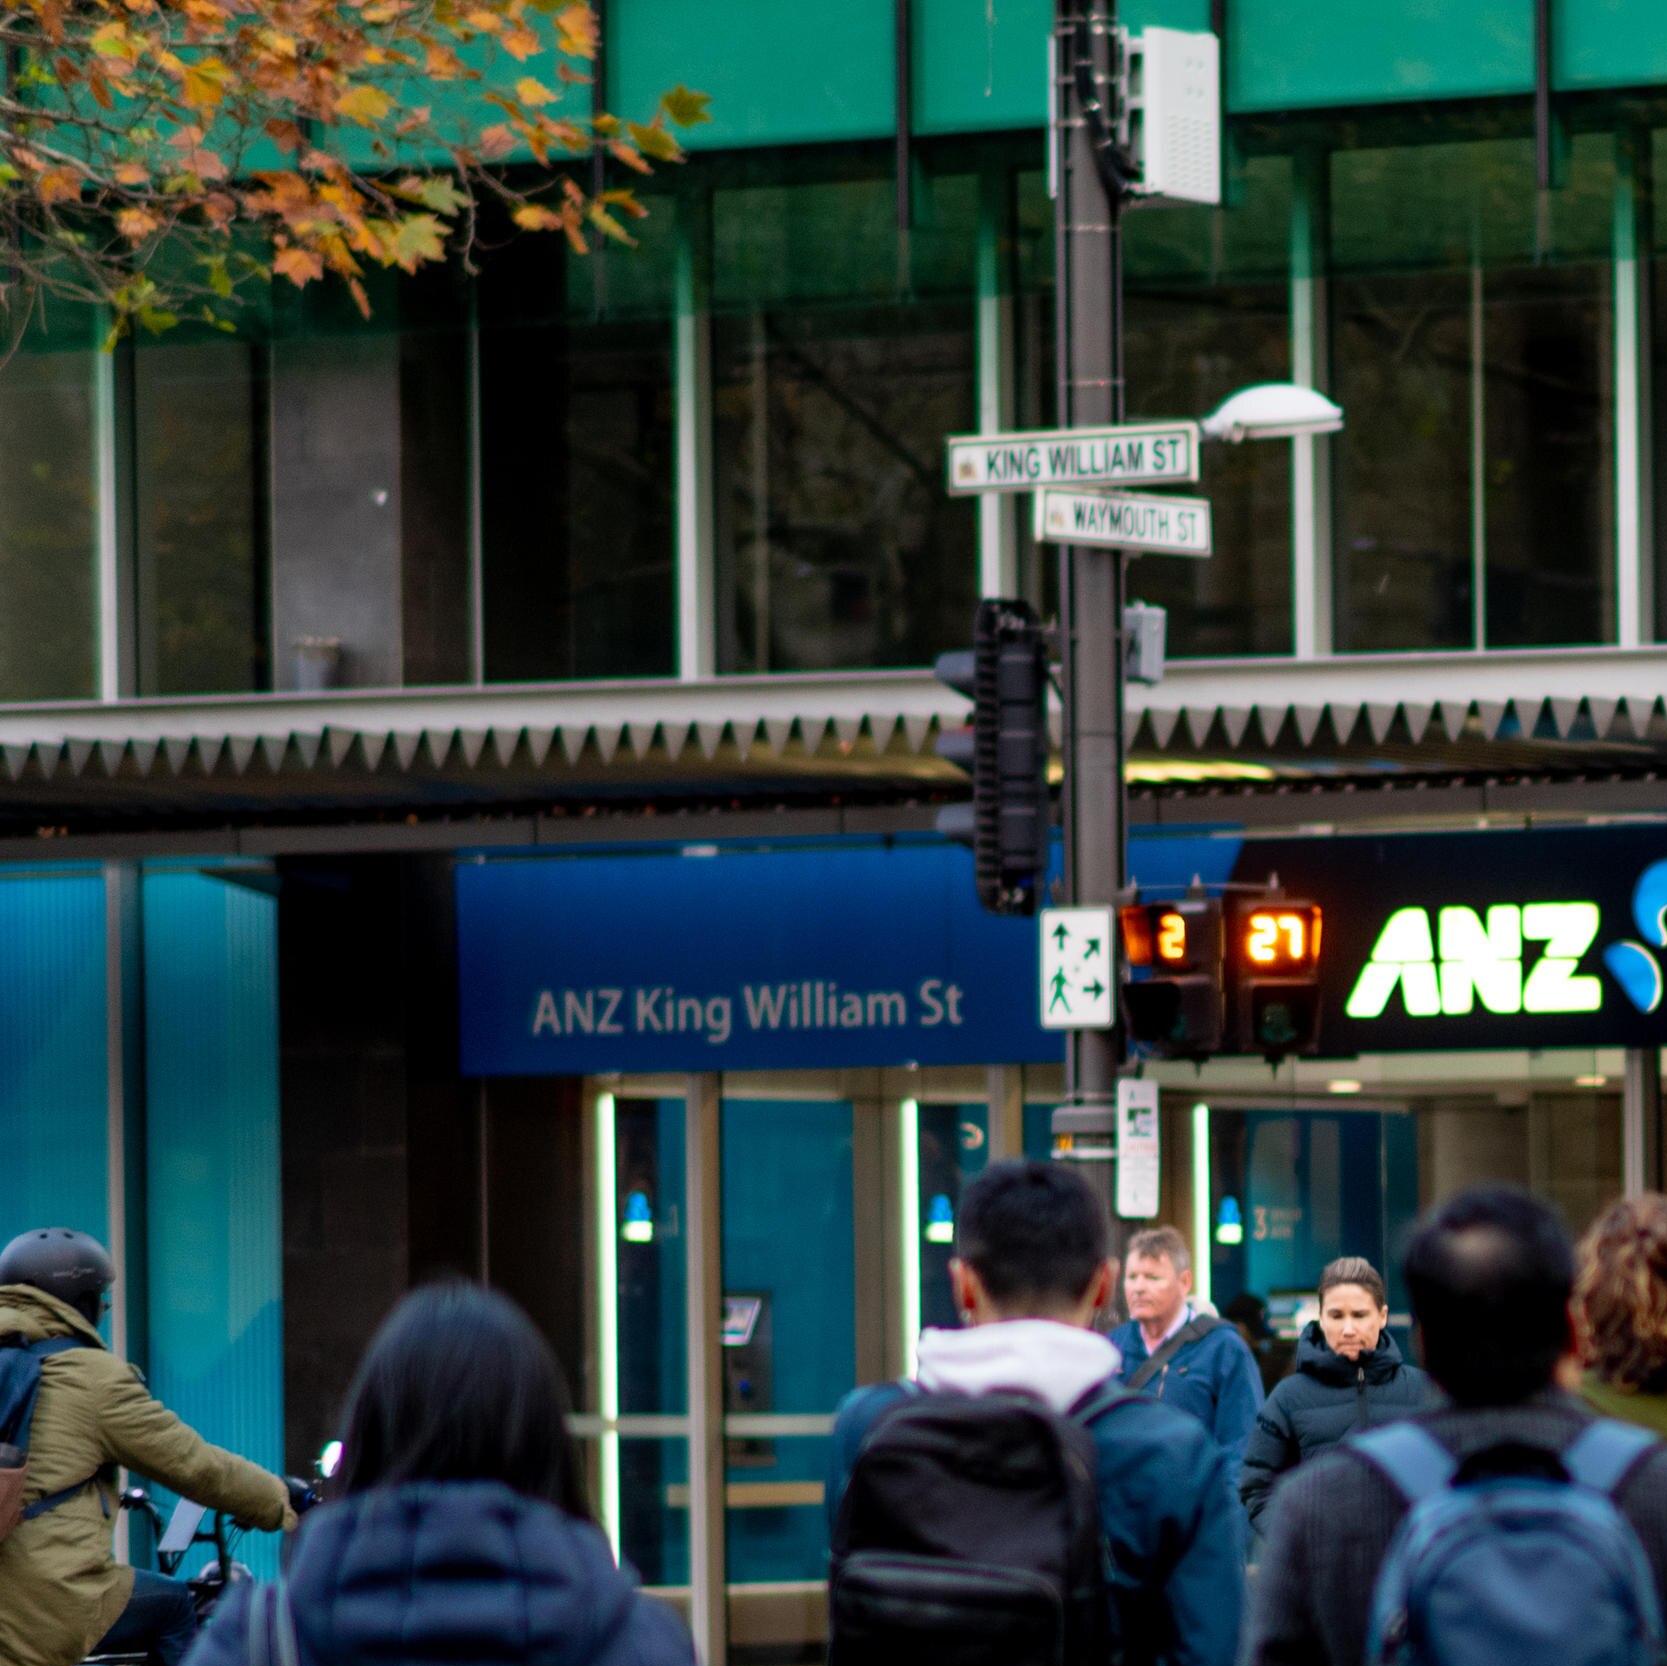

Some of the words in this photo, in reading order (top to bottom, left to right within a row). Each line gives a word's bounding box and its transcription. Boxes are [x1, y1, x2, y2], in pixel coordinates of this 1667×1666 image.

[986, 446, 1041, 480] KING
[1049, 442, 1144, 477] WILLIAM
[1152, 438, 1181, 470] ST
[1074, 500, 1170, 540] WAYMOUTH
[1177, 512, 1198, 542] ST
[1248, 914, 1304, 962] 27
[1345, 902, 1602, 1018] ANZ
[532, 988, 624, 1037] ANZ
[635, 986, 732, 1044] King
[742, 981, 907, 1031] William
[917, 978, 963, 1027] St
